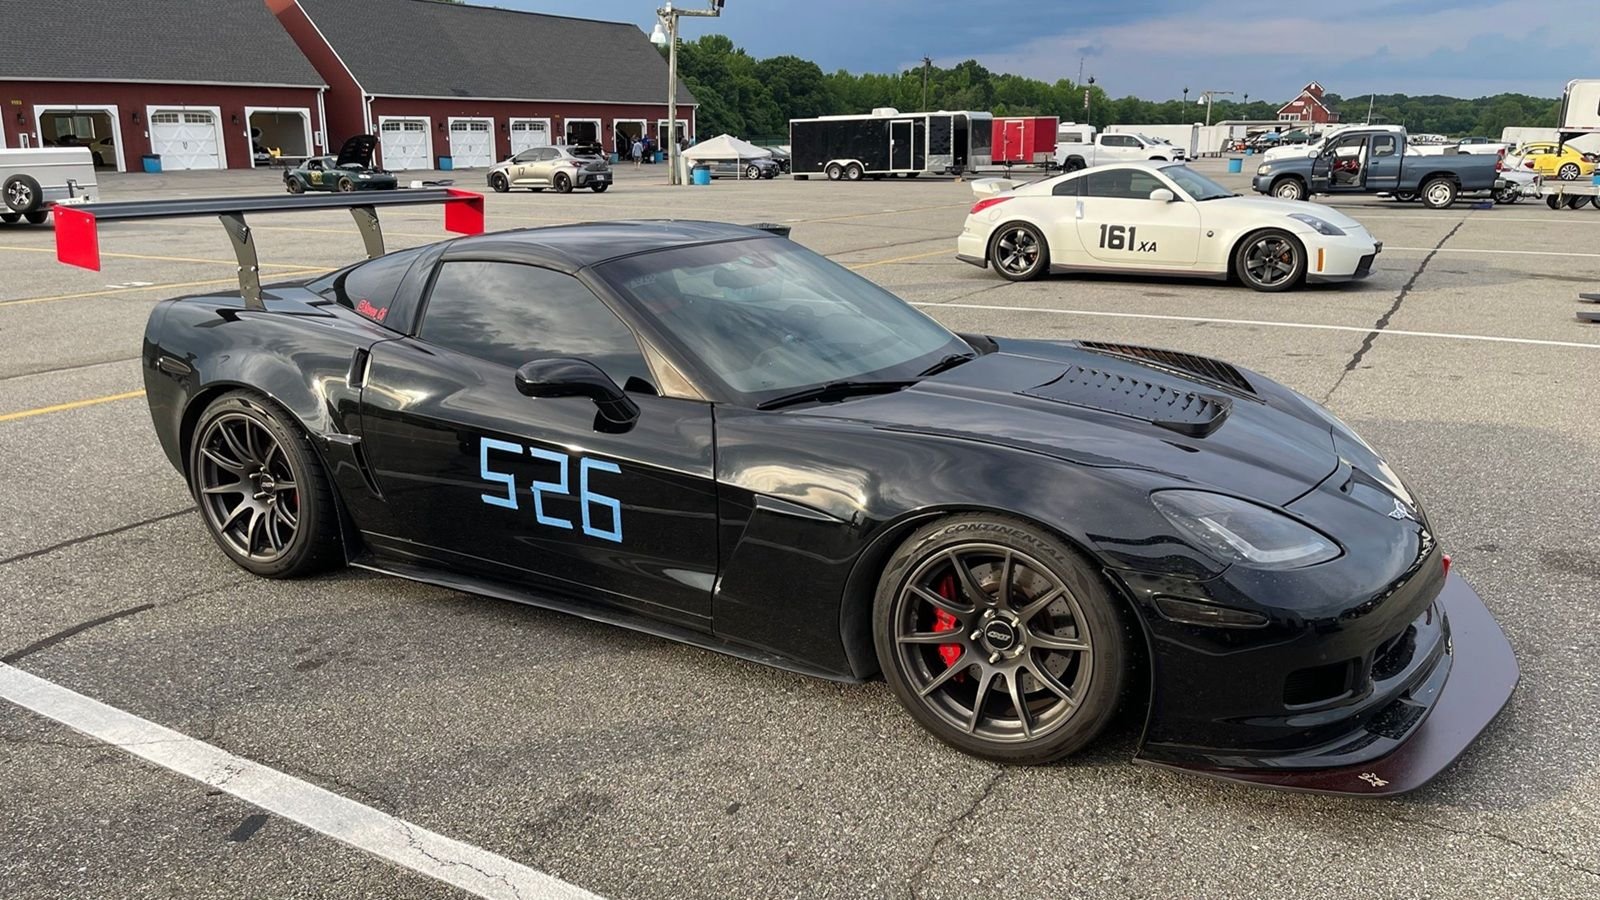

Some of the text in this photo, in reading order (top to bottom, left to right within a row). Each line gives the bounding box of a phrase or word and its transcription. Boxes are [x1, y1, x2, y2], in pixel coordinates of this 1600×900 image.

[518, 167, 526, 176] 17
[1099, 224, 1157, 252] 161 XA
[480, 437, 623, 543] 526
[944, 523, 1065, 564] CONTINENTAL
